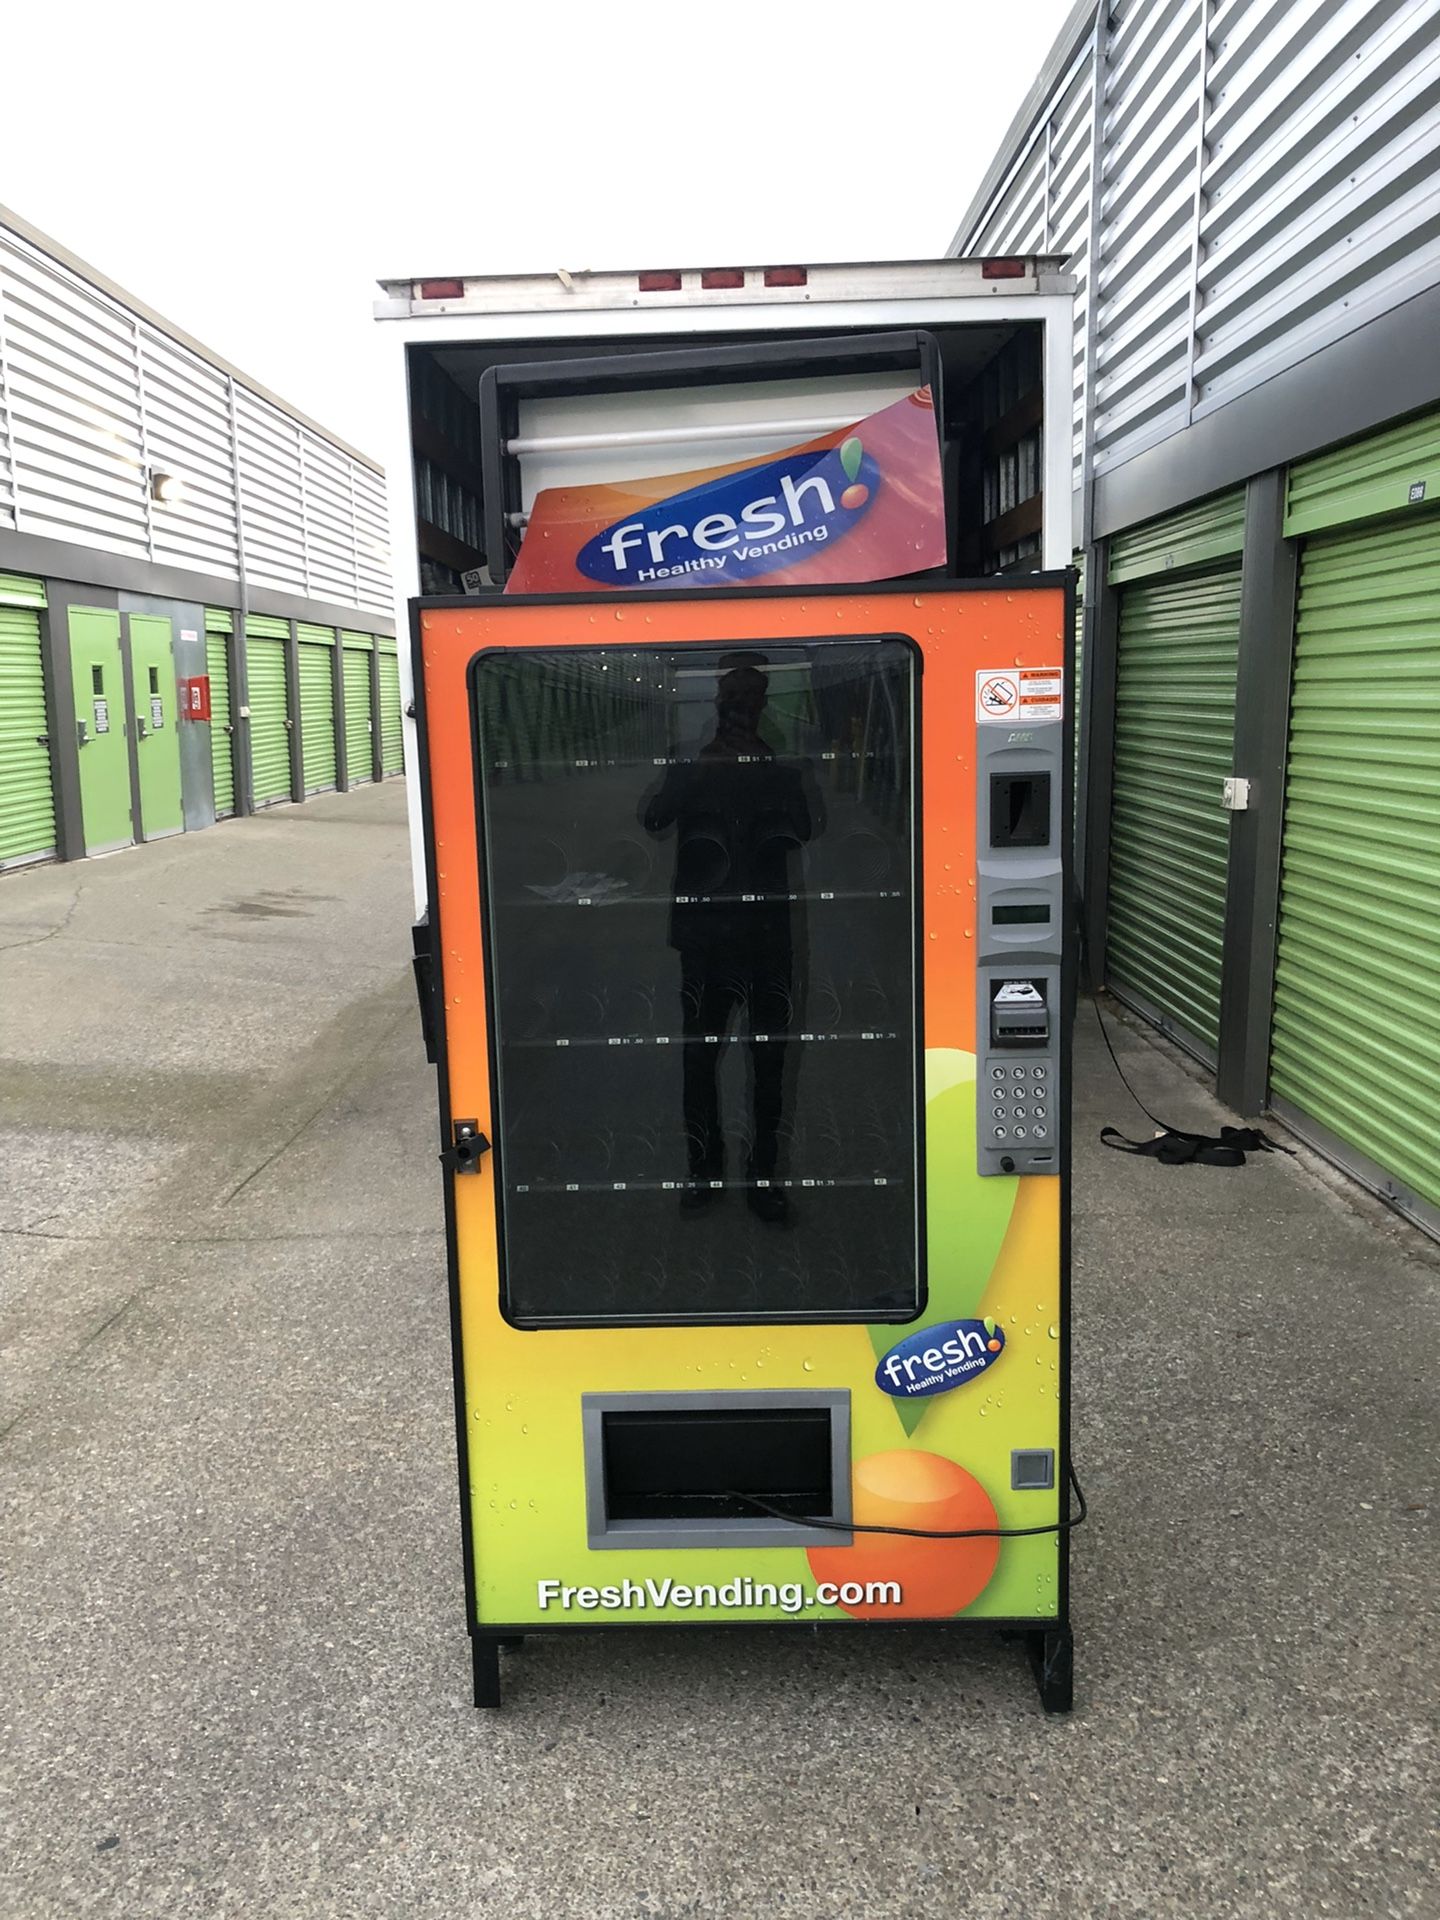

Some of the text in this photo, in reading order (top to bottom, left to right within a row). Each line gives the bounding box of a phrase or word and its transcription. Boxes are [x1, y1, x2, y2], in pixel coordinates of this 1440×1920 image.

[637, 524, 828, 581] Healthy Vending
[466, 573, 479, 582] 50
[906, 1357, 986, 1393] Healthy Vending
[537, 1578, 902, 1613] FreshVending.com
